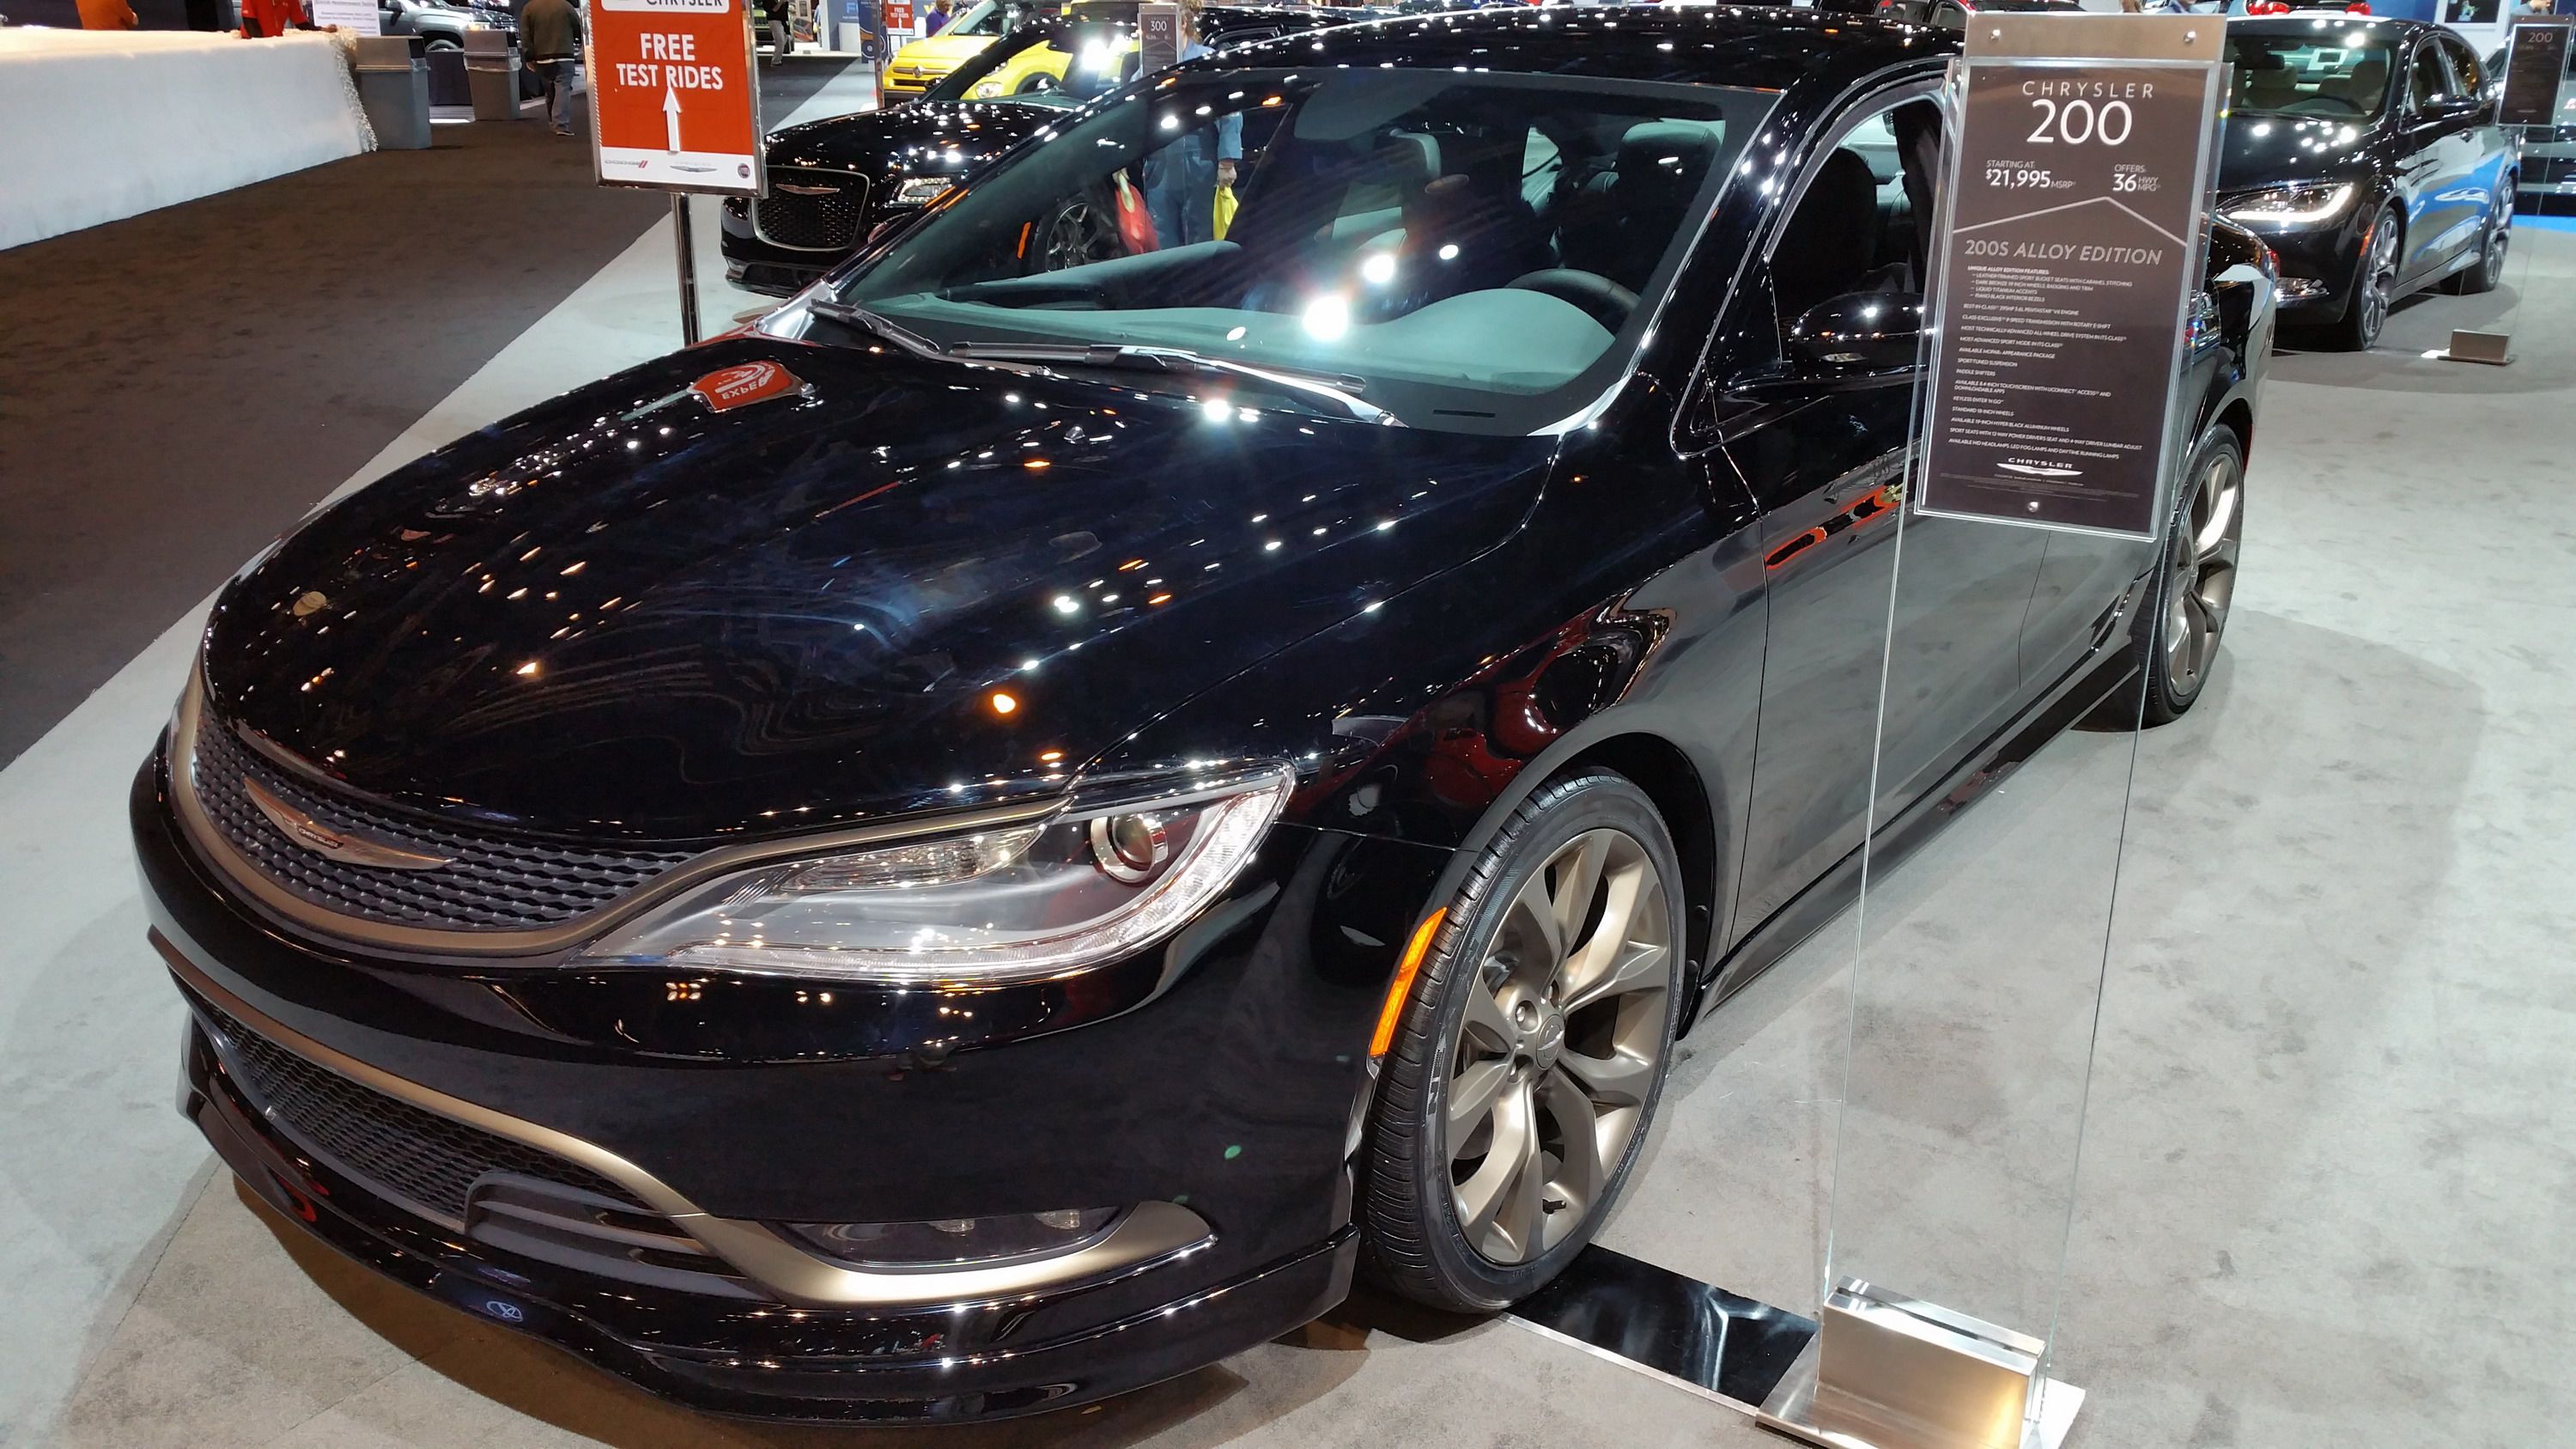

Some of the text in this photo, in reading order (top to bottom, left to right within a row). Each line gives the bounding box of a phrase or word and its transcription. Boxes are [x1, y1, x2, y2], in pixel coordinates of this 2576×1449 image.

[1151, 21, 1167, 32] 300
[2527, 32, 2554, 43] 200
[640, 33, 696, 61] FREE
[616, 64, 724, 90] TEST RIDES
[2022, 81, 2154, 99] CHRYSLER
[2026, 98, 2133, 145] 200
[1986, 160, 2024, 168] STARTING
[1985, 168, 2051, 190] $21,995
[2112, 174, 2137, 192] 36
[1965, 239, 2162, 265] 200S ALLOY EDITION
[2008, 457, 2073, 469] CHRYSLER
